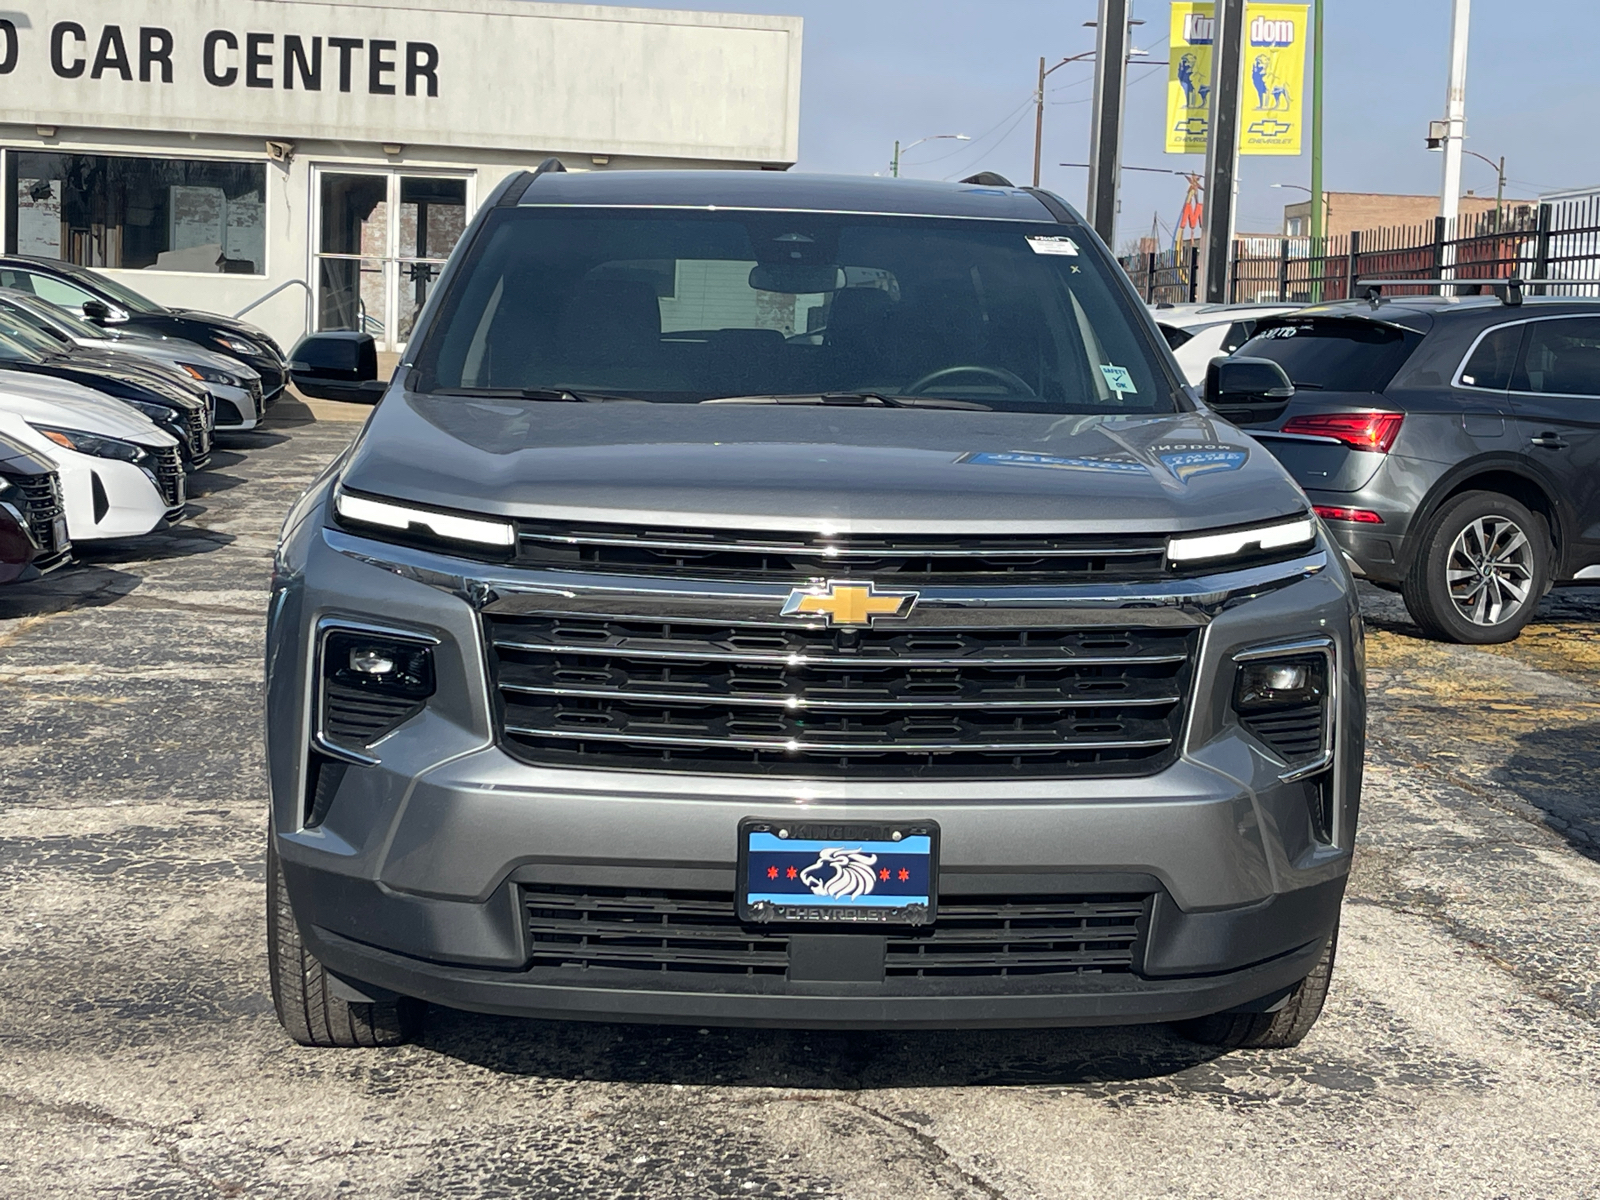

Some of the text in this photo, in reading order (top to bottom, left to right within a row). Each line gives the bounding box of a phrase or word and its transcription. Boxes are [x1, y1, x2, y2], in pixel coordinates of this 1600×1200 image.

[1184, 14, 1214, 44] Kin
[1251, 15, 1294, 46] dom
[50, 21, 174, 84] CAR
[203, 29, 439, 98] CENTER
[790, 825, 891, 840] KINGDOM
[785, 908, 889, 921] CHEVROLET
